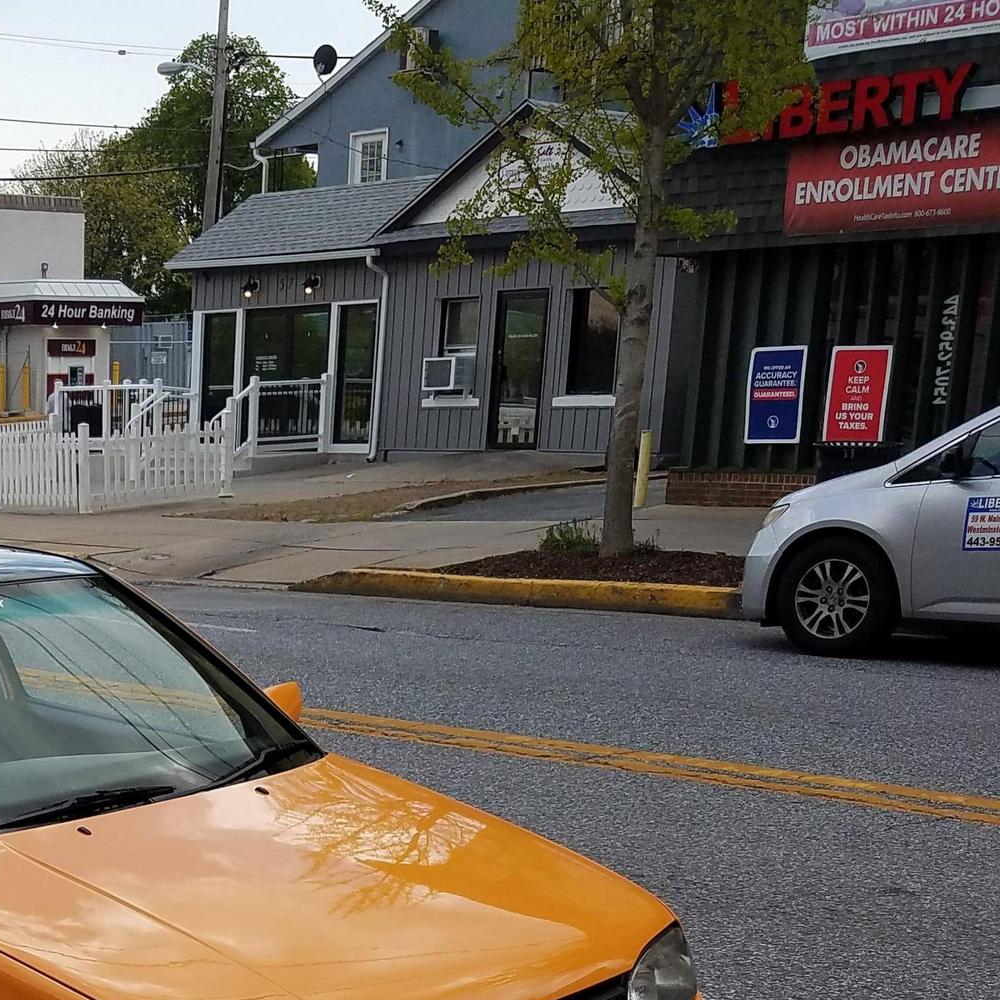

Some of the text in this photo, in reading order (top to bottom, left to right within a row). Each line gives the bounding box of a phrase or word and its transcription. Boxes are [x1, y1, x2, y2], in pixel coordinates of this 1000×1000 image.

[816, 18, 867, 42] MOST
[873, 7, 938, 33] WITHIN
[944, 3, 966, 23] 24
[839, 133, 982, 170] OBAMACARE
[795, 171, 934, 205] ENROLLMENT
[41, 304, 135, 322] 24 Hour Banking
[755, 371, 797, 380] ACCURACY
[848, 376, 870, 384] KEEP
[841, 403, 869, 411] BRING
[835, 412, 873, 420] US YOUR
[839, 422, 868, 430] TAXES.
